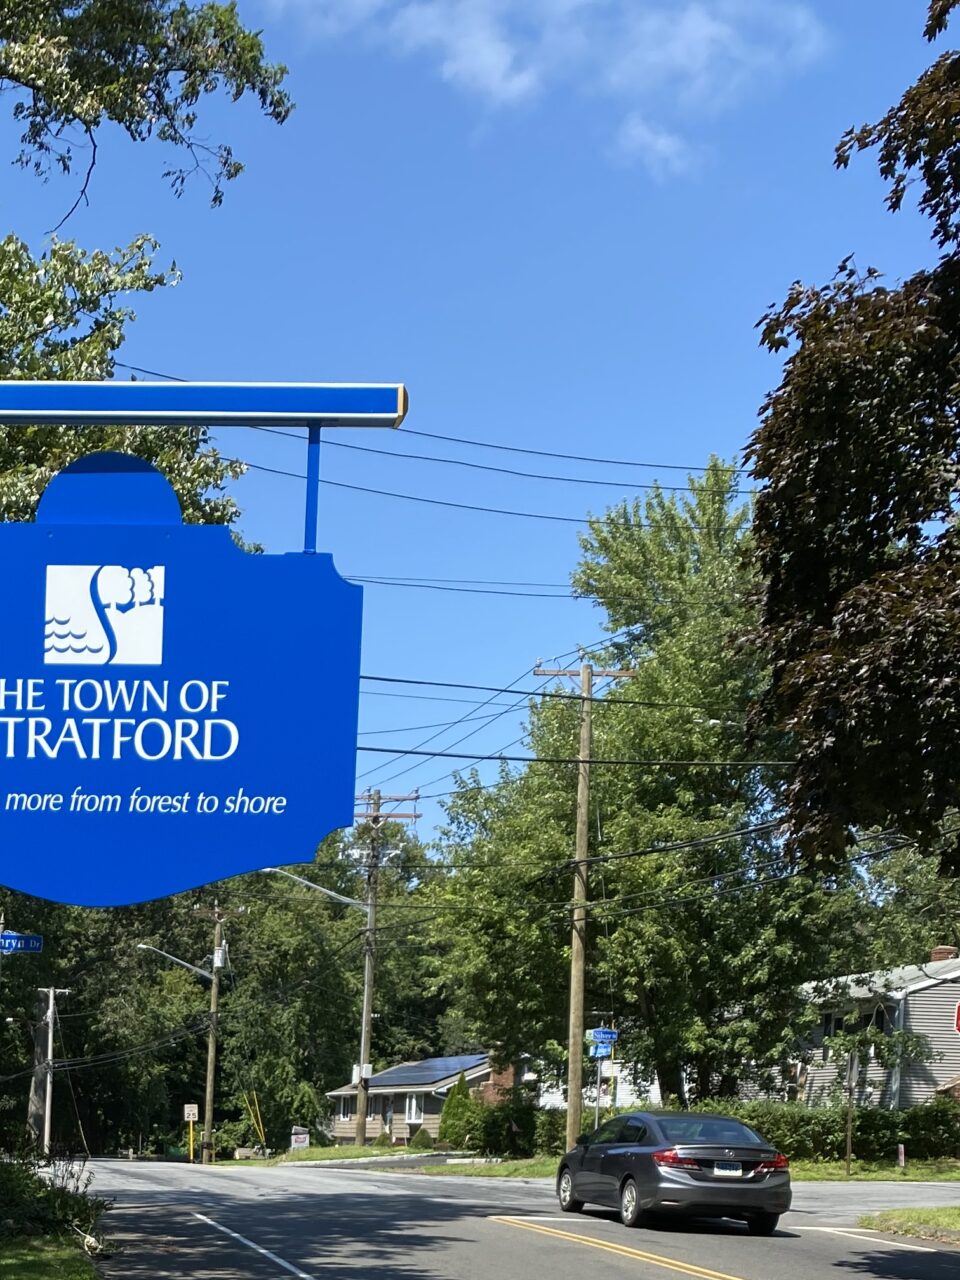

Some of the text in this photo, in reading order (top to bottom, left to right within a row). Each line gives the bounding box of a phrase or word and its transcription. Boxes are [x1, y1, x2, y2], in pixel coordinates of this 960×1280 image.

[55, 678, 169, 712] TOWN
[179, 679, 229, 713] OF
[5, 793, 64, 811] more
[69, 786, 122, 812] from
[129, 786, 191, 813] forest
[196, 792, 219, 813] to
[223, 787, 287, 814] shore
[29, 940, 41, 948] Dr
